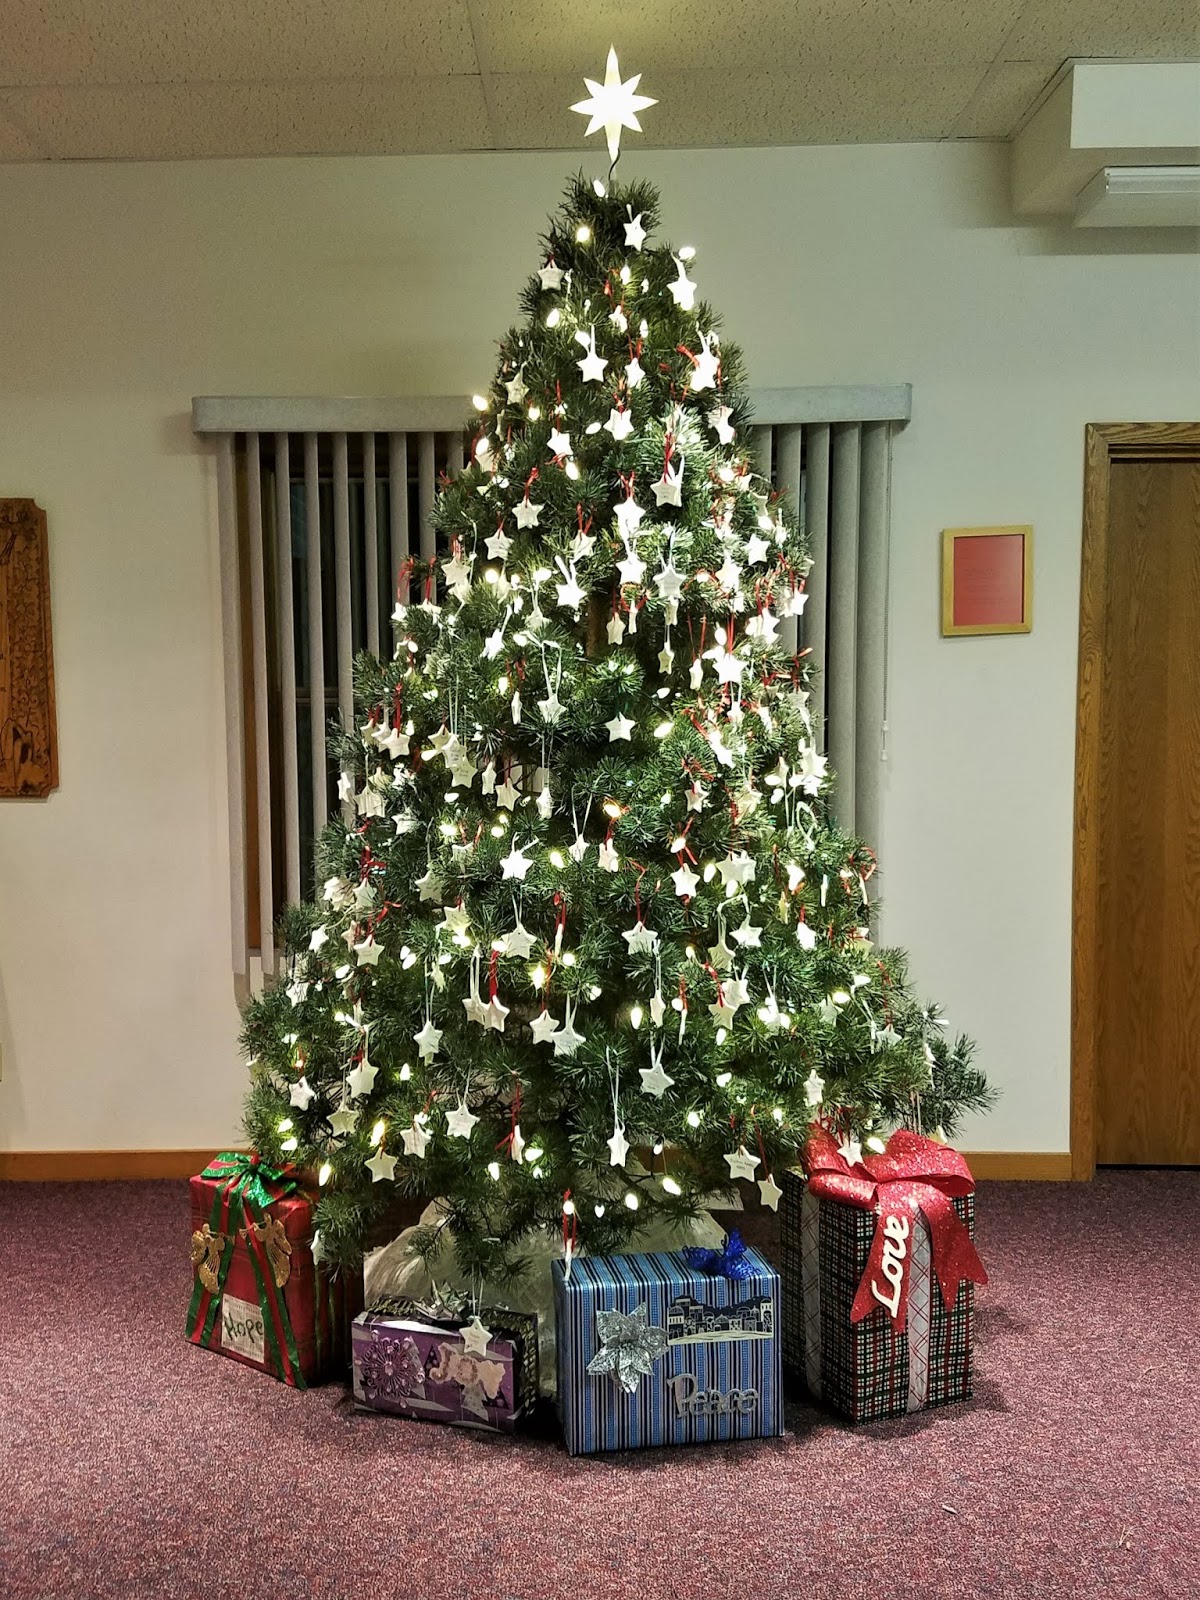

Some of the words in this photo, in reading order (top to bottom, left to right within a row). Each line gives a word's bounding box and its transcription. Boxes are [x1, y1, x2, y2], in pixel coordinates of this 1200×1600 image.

[871, 1215, 909, 1318] Love
[224, 1313, 263, 1343] Hope
[666, 1373, 759, 1419] Peace
